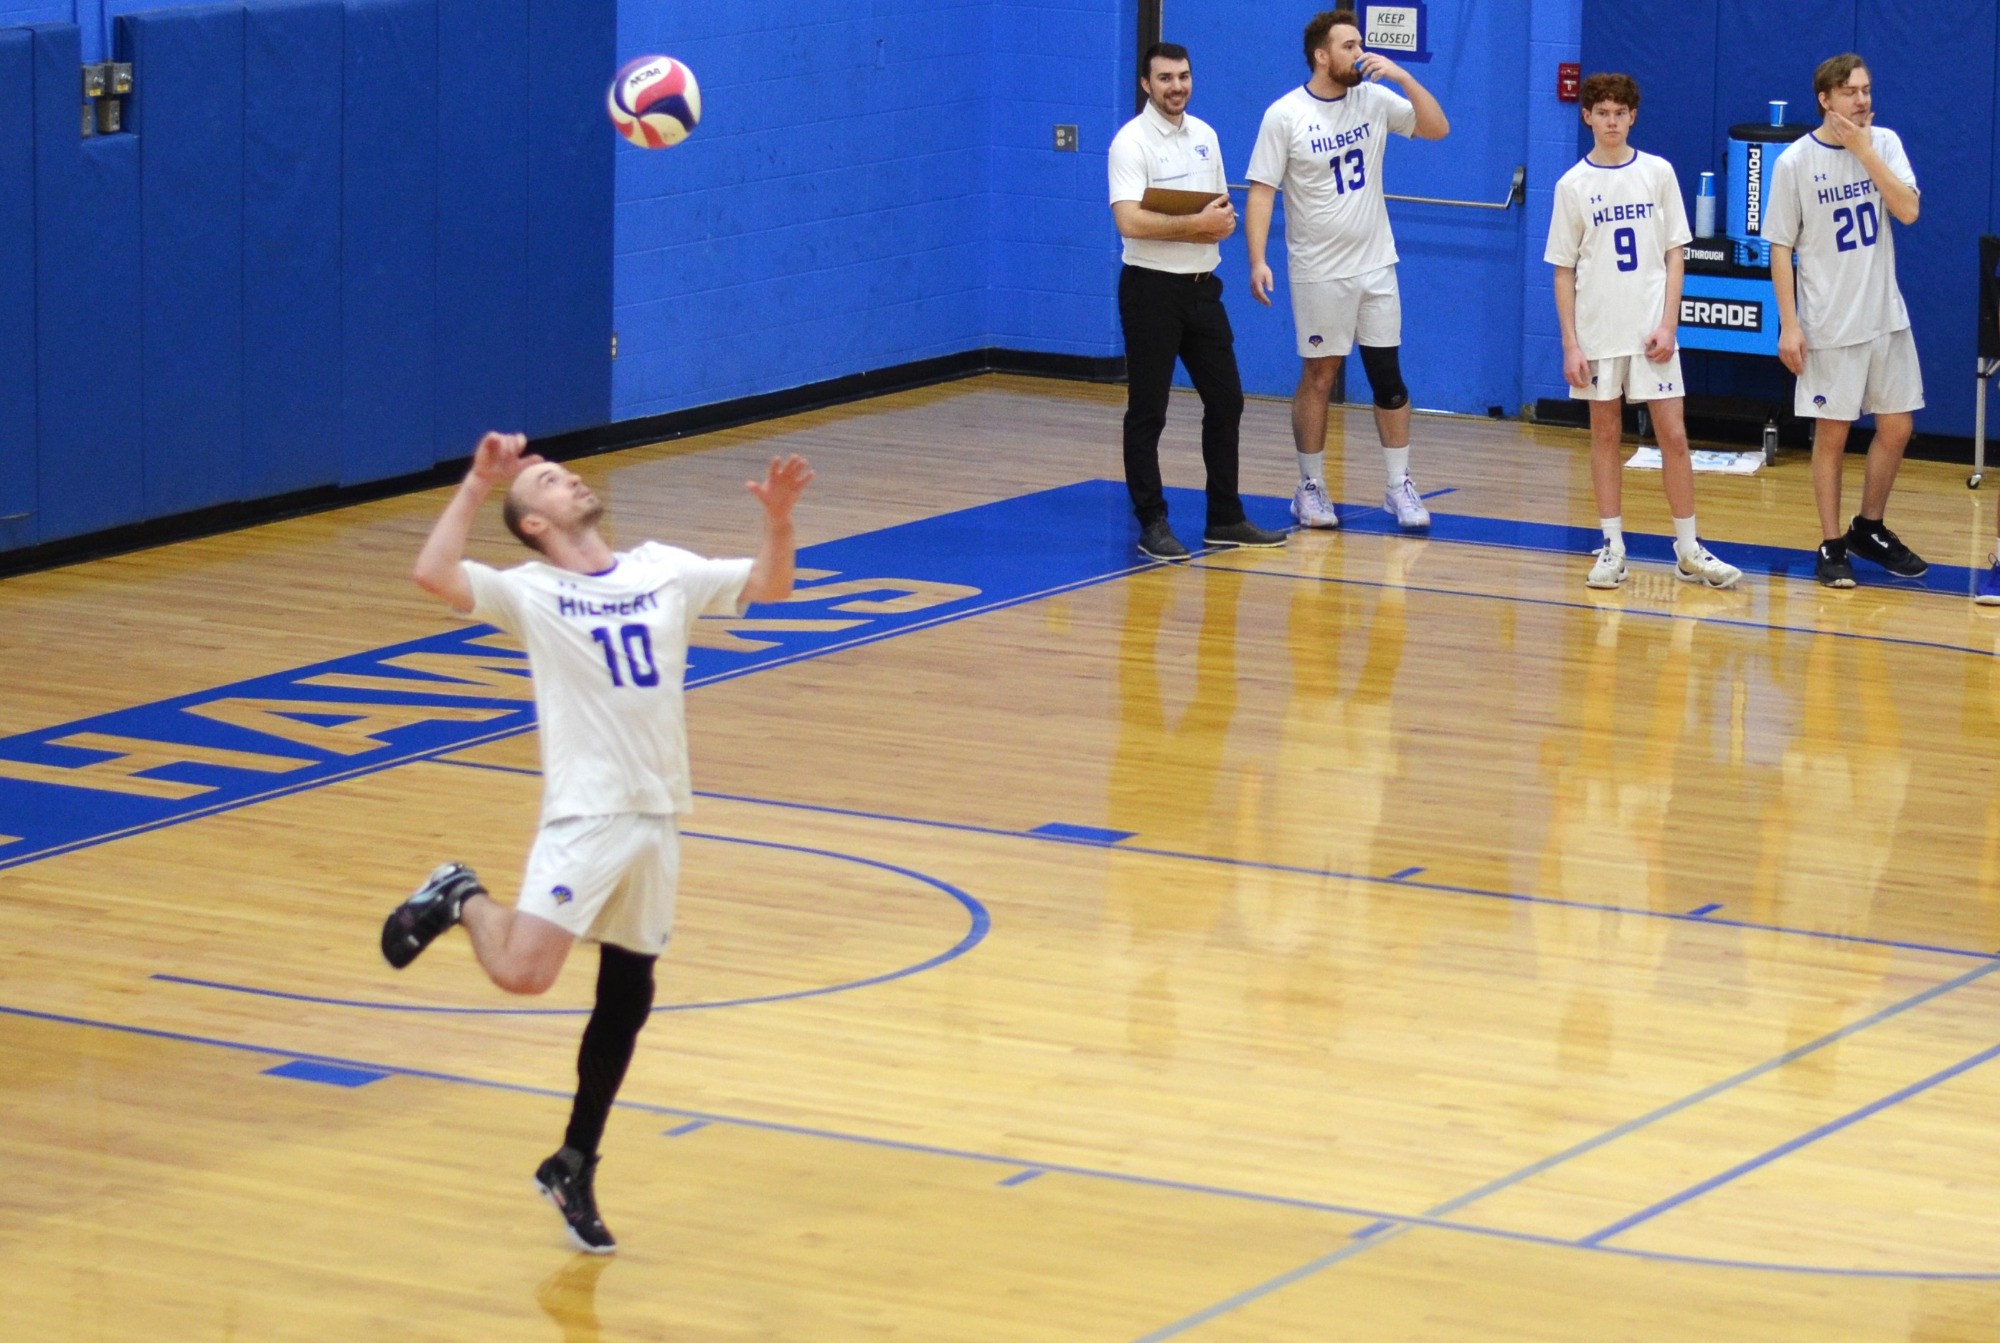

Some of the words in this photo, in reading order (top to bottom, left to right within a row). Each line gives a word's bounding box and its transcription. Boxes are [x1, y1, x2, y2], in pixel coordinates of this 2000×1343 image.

[1377, 12, 1405, 24] KEEP
[1367, 32, 1415, 45] CLOSED!
[630, 67, 661, 87] NCAA
[1311, 123, 1370, 153] HILBERT
[1329, 148, 1366, 195] 13
[1747, 148, 1760, 231] POWERADE
[1592, 203, 1654, 227] HLBERT
[1833, 201, 1878, 252] 20
[1613, 227, 1638, 272] 9
[1690, 249, 1724, 261] THROUGH
[1680, 301, 1758, 327] ERADE
[590, 623, 660, 687] 10
